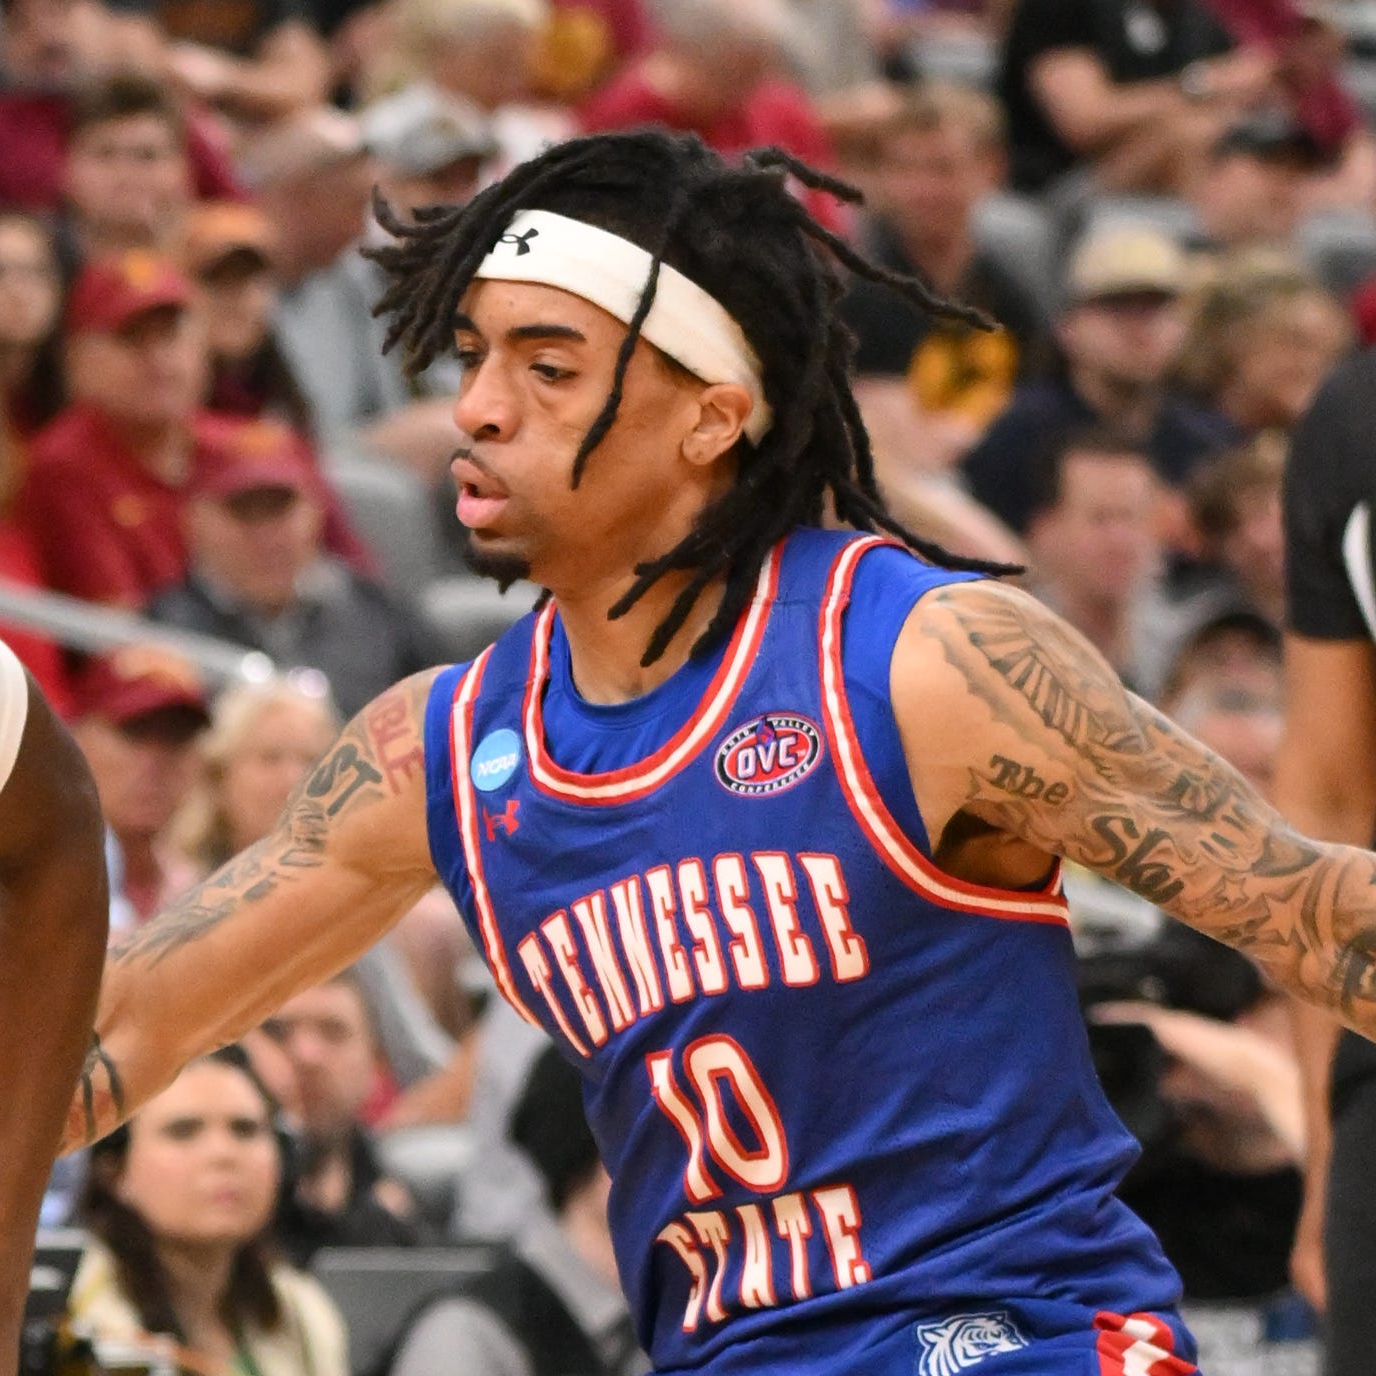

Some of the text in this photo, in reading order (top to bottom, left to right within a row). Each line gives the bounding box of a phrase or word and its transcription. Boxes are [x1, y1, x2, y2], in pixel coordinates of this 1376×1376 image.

[477, 752, 516, 778] NCAA
[737, 734, 798, 780] OVC
[989, 754, 1070, 806] The
[517, 851, 870, 1058] TENNESSEE
[645, 1032, 789, 1205] 10
[655, 1183, 873, 1333] STATE
